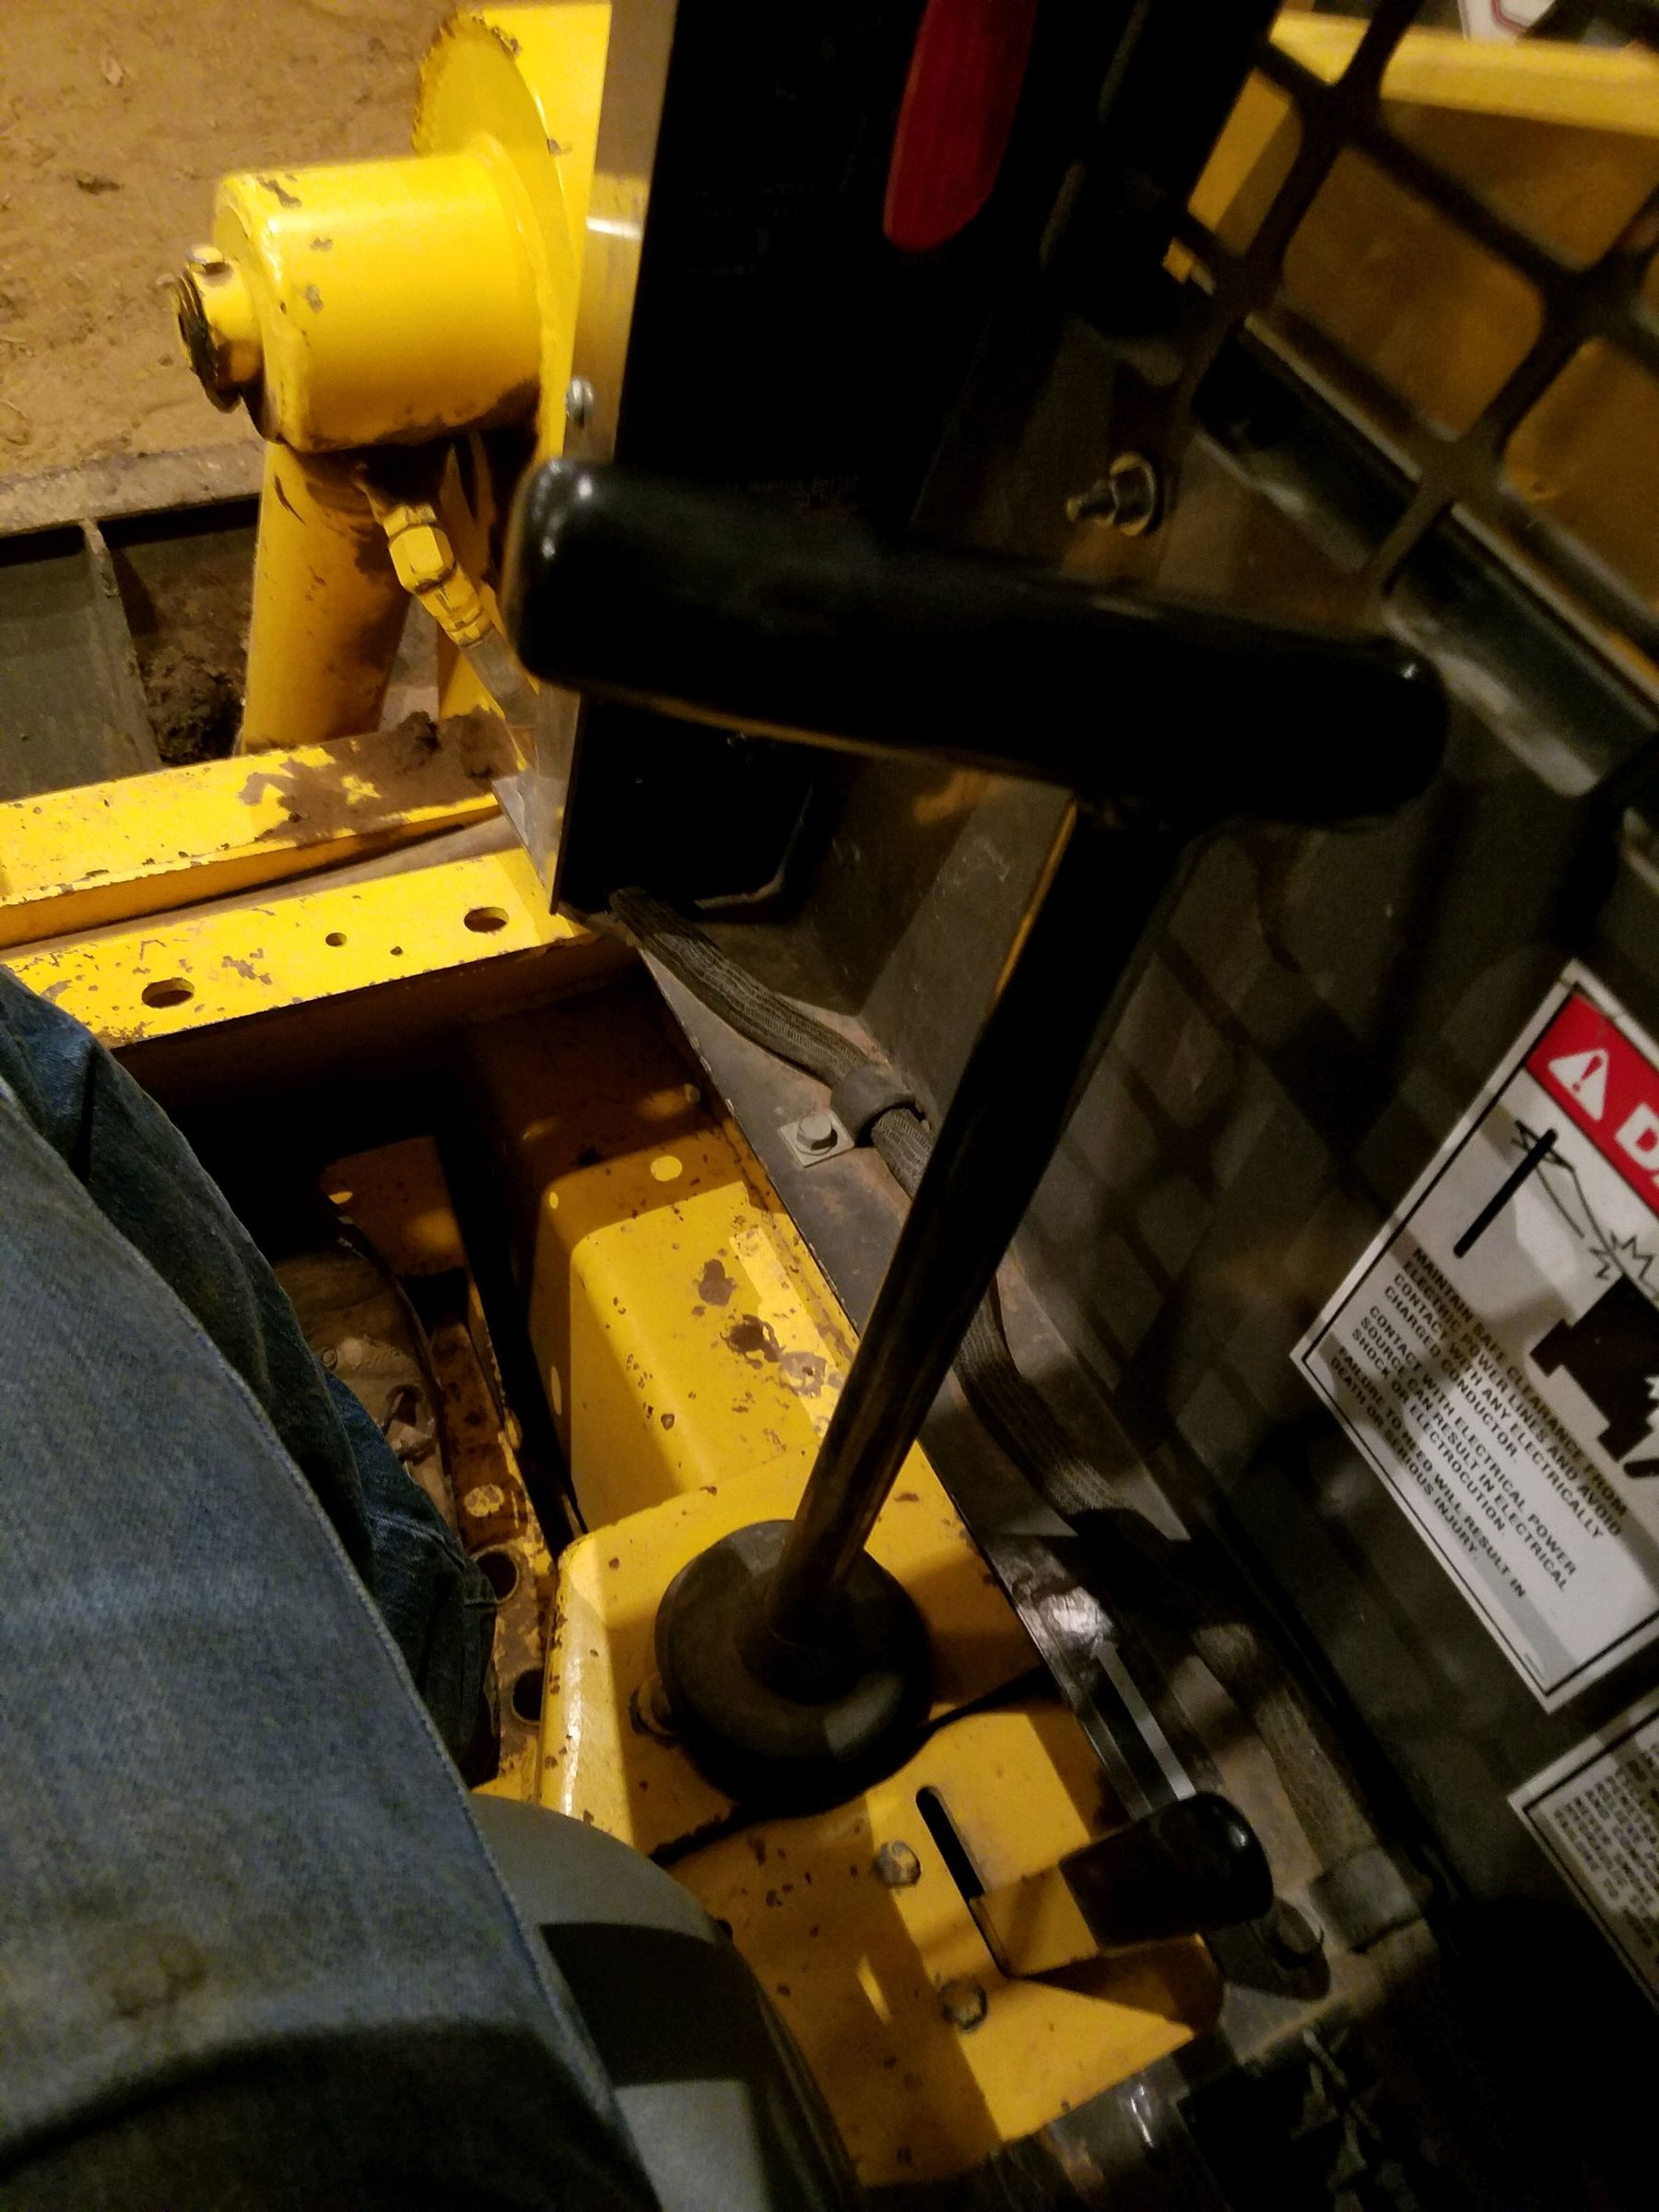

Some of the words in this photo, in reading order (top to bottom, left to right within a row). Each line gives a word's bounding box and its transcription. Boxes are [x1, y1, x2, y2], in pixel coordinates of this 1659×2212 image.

[1329, 1354, 1368, 1406] DEATH
[1365, 1404, 1384, 1429] OR
[1382, 1428, 1434, 1496] SERIOUS
[1351, 1326, 1391, 1380] SHOCK
[1389, 1378, 1410, 1405] OR
[1359, 1314, 1408, 1380] SOURCE
[1406, 1376, 1433, 1412] CAN
[1431, 1409, 1479, 1471] RESULT
[1477, 1472, 1496, 1493] IN
[1492, 1492, 1571, 1592] ELECTRICAL
[1368, 1303, 1422, 1374] CONTACT
[1420, 1372, 1455, 1417] WITH
[1453, 1415, 1530, 1513] ELECTRICAL
[1525, 1512, 1578, 1577] POWER
[1383, 1283, 1441, 1360] CHARGED
[1393, 1271, 1448, 1344] CONTACT
[1446, 1341, 1483, 1388] WITH
[1480, 1384, 1512, 1423] ANY
[1508, 1420, 1604, 1541] ELECTRICALLY
[1402, 1257, 1463, 1335] ELECTRIC
[1459, 1331, 1509, 1394] POWER
[1507, 1392, 1549, 1443] LINES
[1546, 1442, 1580, 1482] AND
[1575, 1481, 1624, 1538] AVOID
[1412, 1244, 1474, 1324] MAINTAIN
[1471, 1321, 1506, 1364] SAFE
[1504, 1363, 1584, 1462] CLEARANCE
[1582, 1461, 1630, 1518] FROM
[1337, 1344, 1385, 1409] FAILURE
[1383, 1406, 1403, 1431] TO
[1400, 1430, 1434, 1474] HEED
[1431, 1472, 1465, 1515] WILL
[1462, 1513, 1511, 1576] RESULT
[1508, 1577, 1527, 1598] IN
